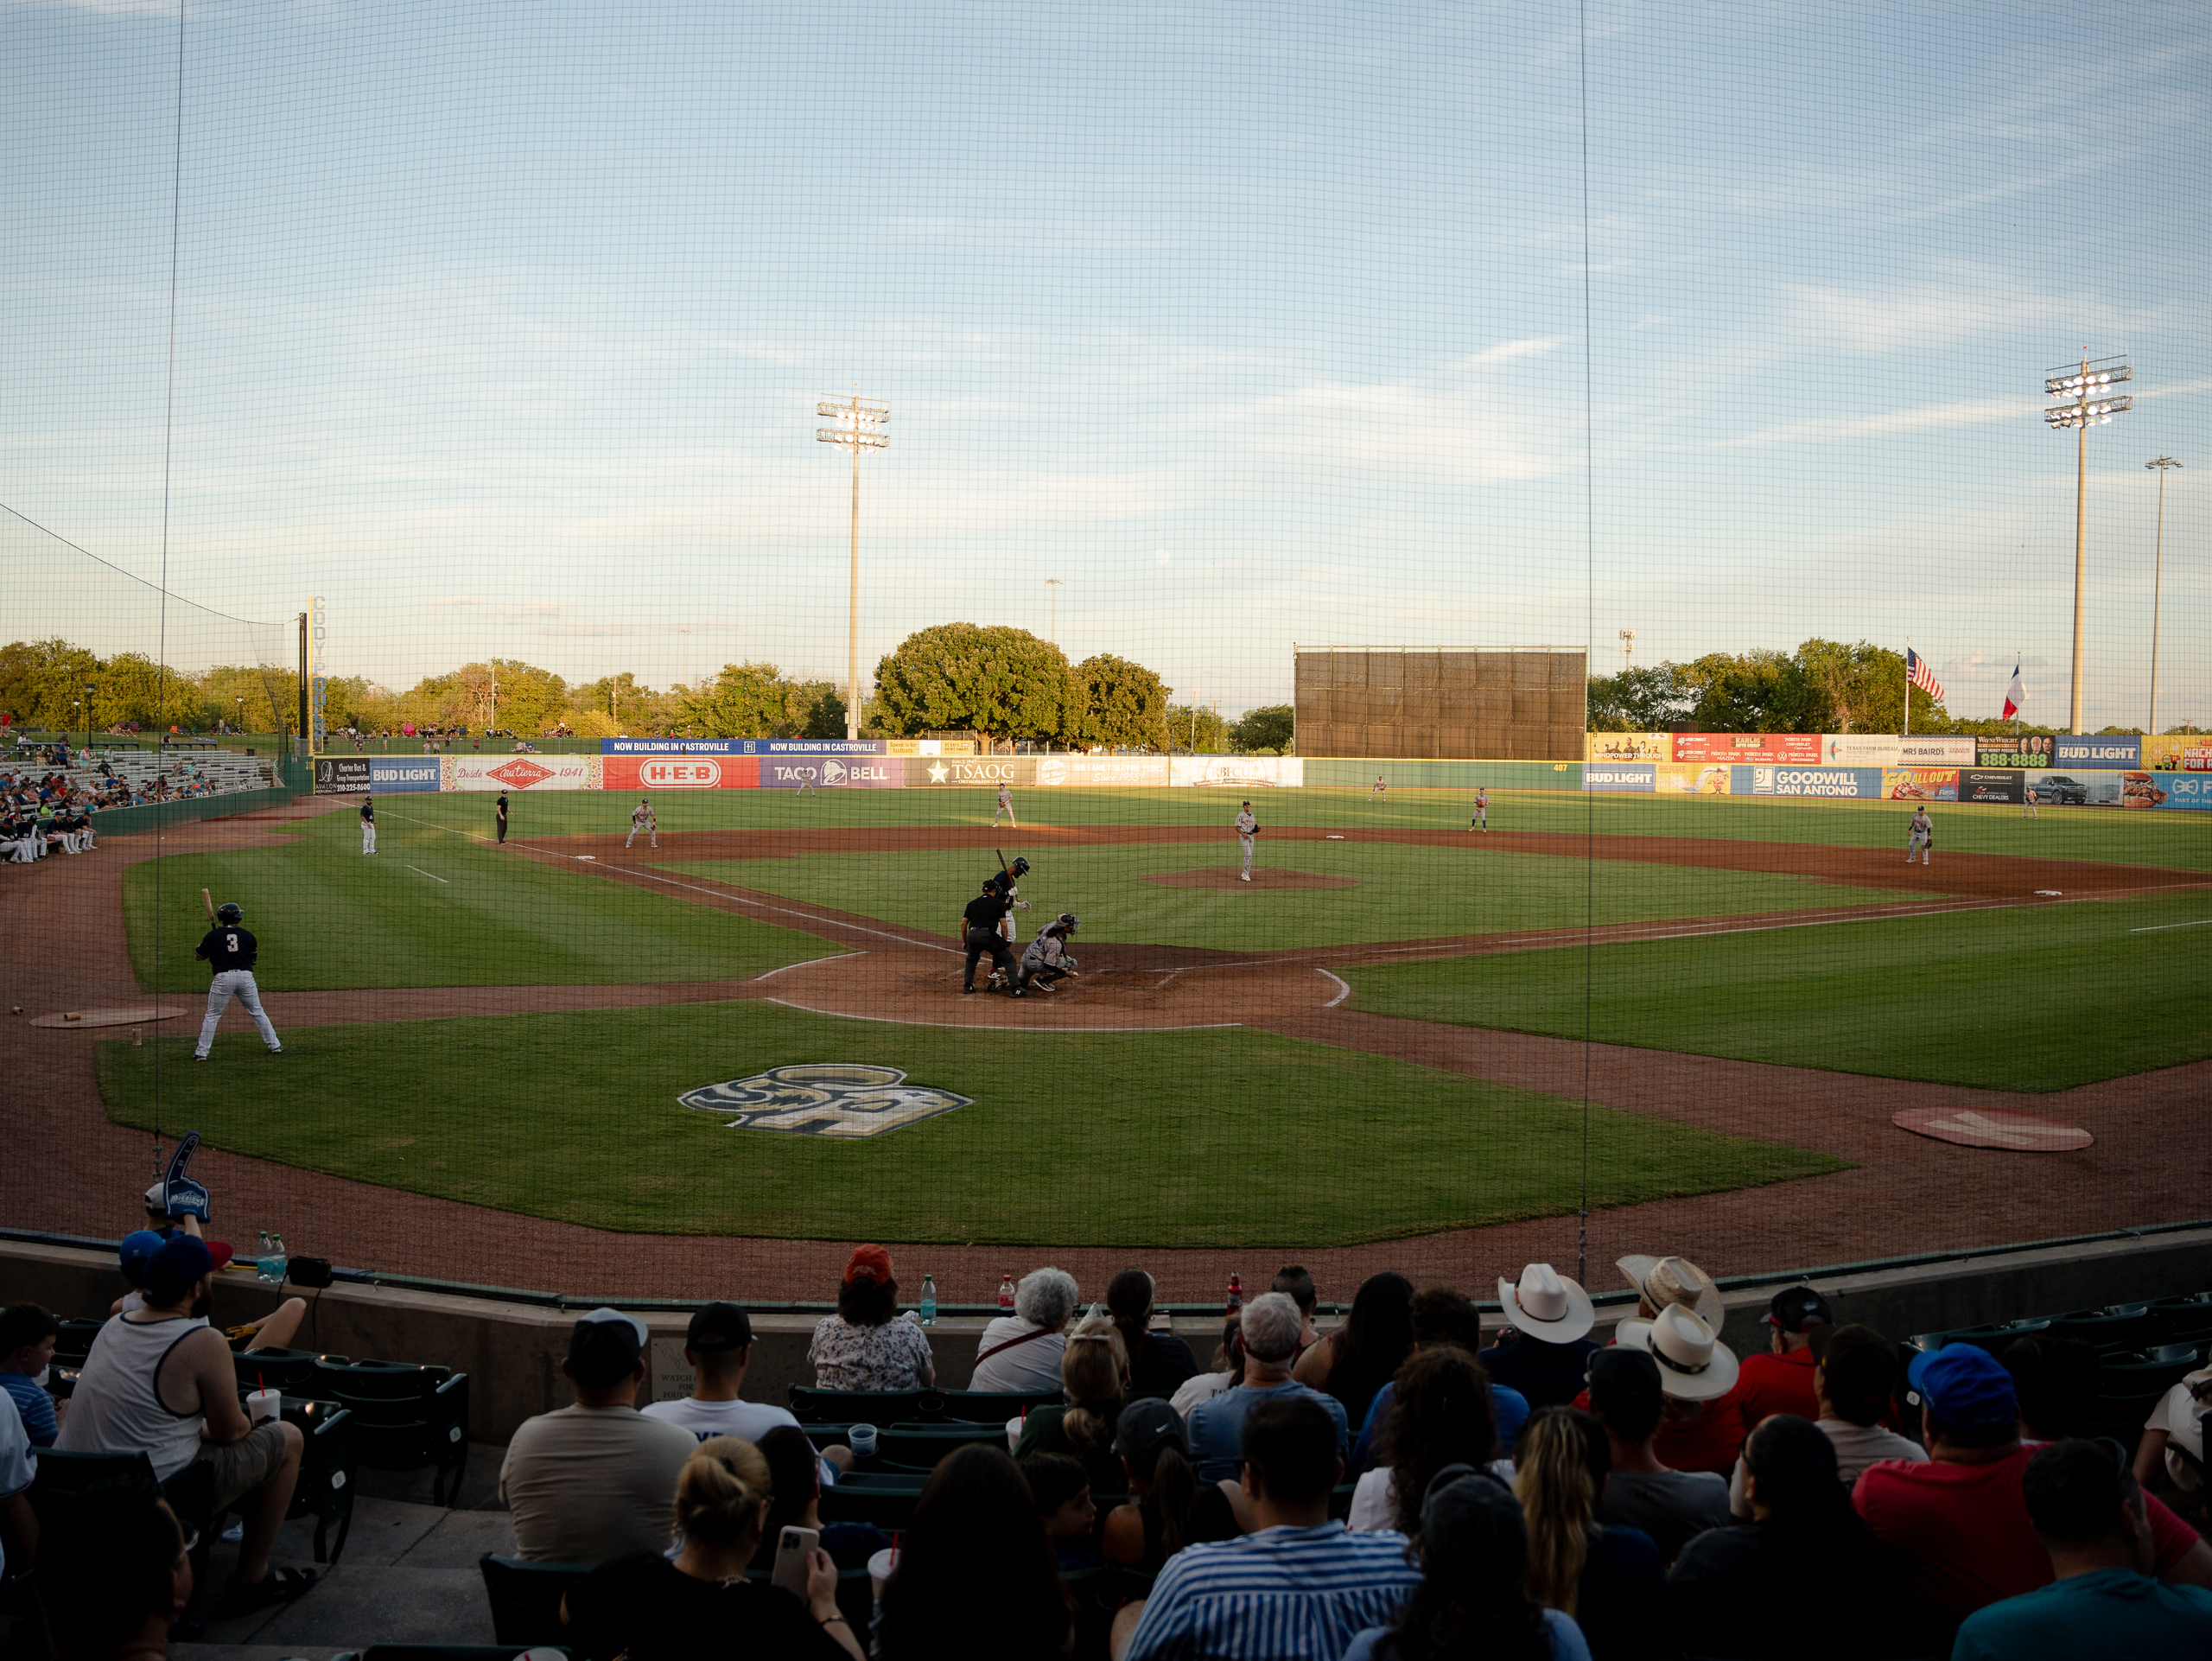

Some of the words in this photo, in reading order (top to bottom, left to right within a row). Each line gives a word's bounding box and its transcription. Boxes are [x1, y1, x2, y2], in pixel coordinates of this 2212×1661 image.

[314, 662, 326, 736] POOLS
[614, 742, 632, 751] NOW
[634, 742, 670, 751] BUILDING
[671, 742, 678, 751] IN
[680, 742, 729, 751] CASTROVILLE
[831, 743, 877, 752] CASTROVILLE
[2059, 748, 2089, 759] BUD
[2091, 748, 2135, 759] LIGHT
[1980, 753, 2047, 767] 888-8888
[2183, 759, 2204, 768] FOR
[339, 763, 353, 772] Charter
[457, 767, 482, 778] Desde
[559, 767, 583, 777] 1941
[951, 764, 1015, 779] TSAOG
[1211, 767, 1250, 777] RBFCU
[373, 769, 397, 781] BUD
[399, 769, 435, 780] LIGHT
[774, 767, 817, 780] TACO
[850, 767, 888, 780] BELL
[1092, 773, 1116, 781] Since
[1118, 773, 1146, 781] 1953!
[1586, 773, 1613, 783] BUD
[1777, 771, 1857, 786] GOODWILL
[1884, 771, 1912, 786] GO
[1912, 772, 1929, 784] ALL
[1929, 770, 1957, 783] OUT
[337, 783, 371, 792] 210-225-8600
[1776, 785, 1801, 794] SAN
[1802, 785, 1858, 796] ANTONIO
[226, 934, 238, 952] 3
[334, 1475, 343, 1485] B
